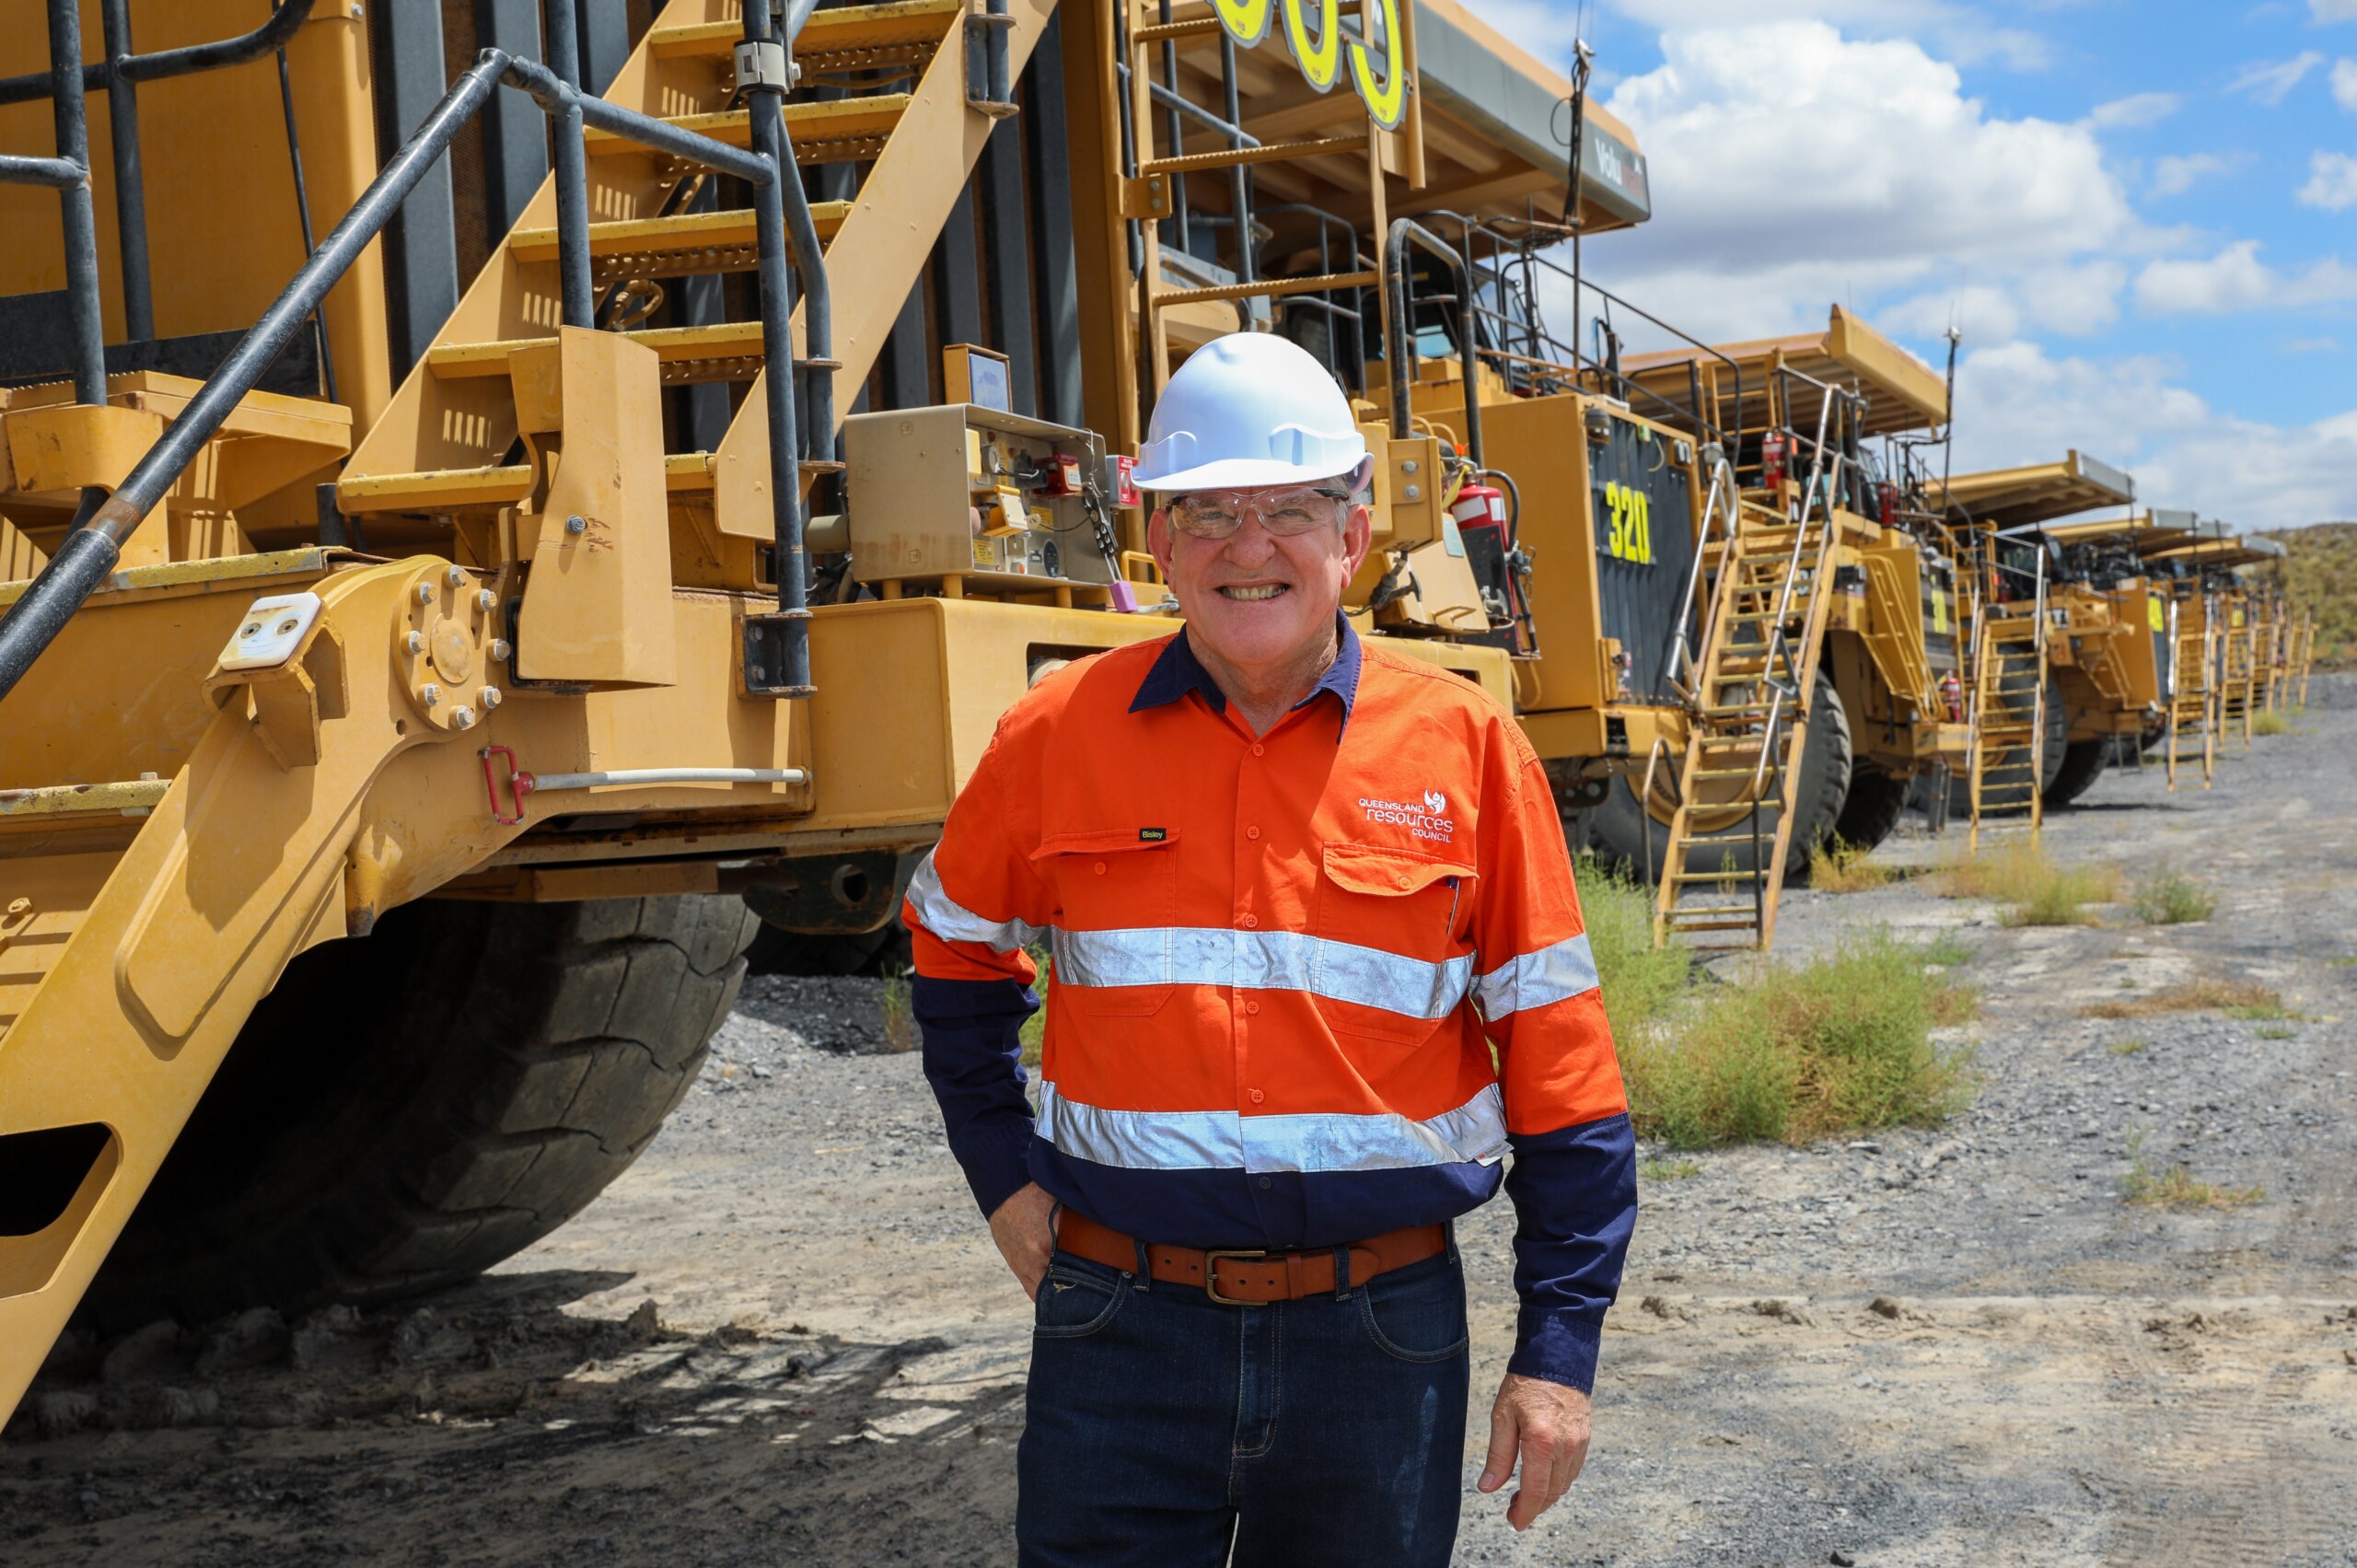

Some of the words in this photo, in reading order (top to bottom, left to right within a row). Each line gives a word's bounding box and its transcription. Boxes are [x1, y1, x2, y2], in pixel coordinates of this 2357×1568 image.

[1606, 482, 1651, 564] 320
[1358, 797, 1425, 813] QUEENSLAND
[1366, 808, 1454, 833] resources
[1142, 830, 1163, 839] Bisley
[1411, 828, 1452, 843] COUNCIL
